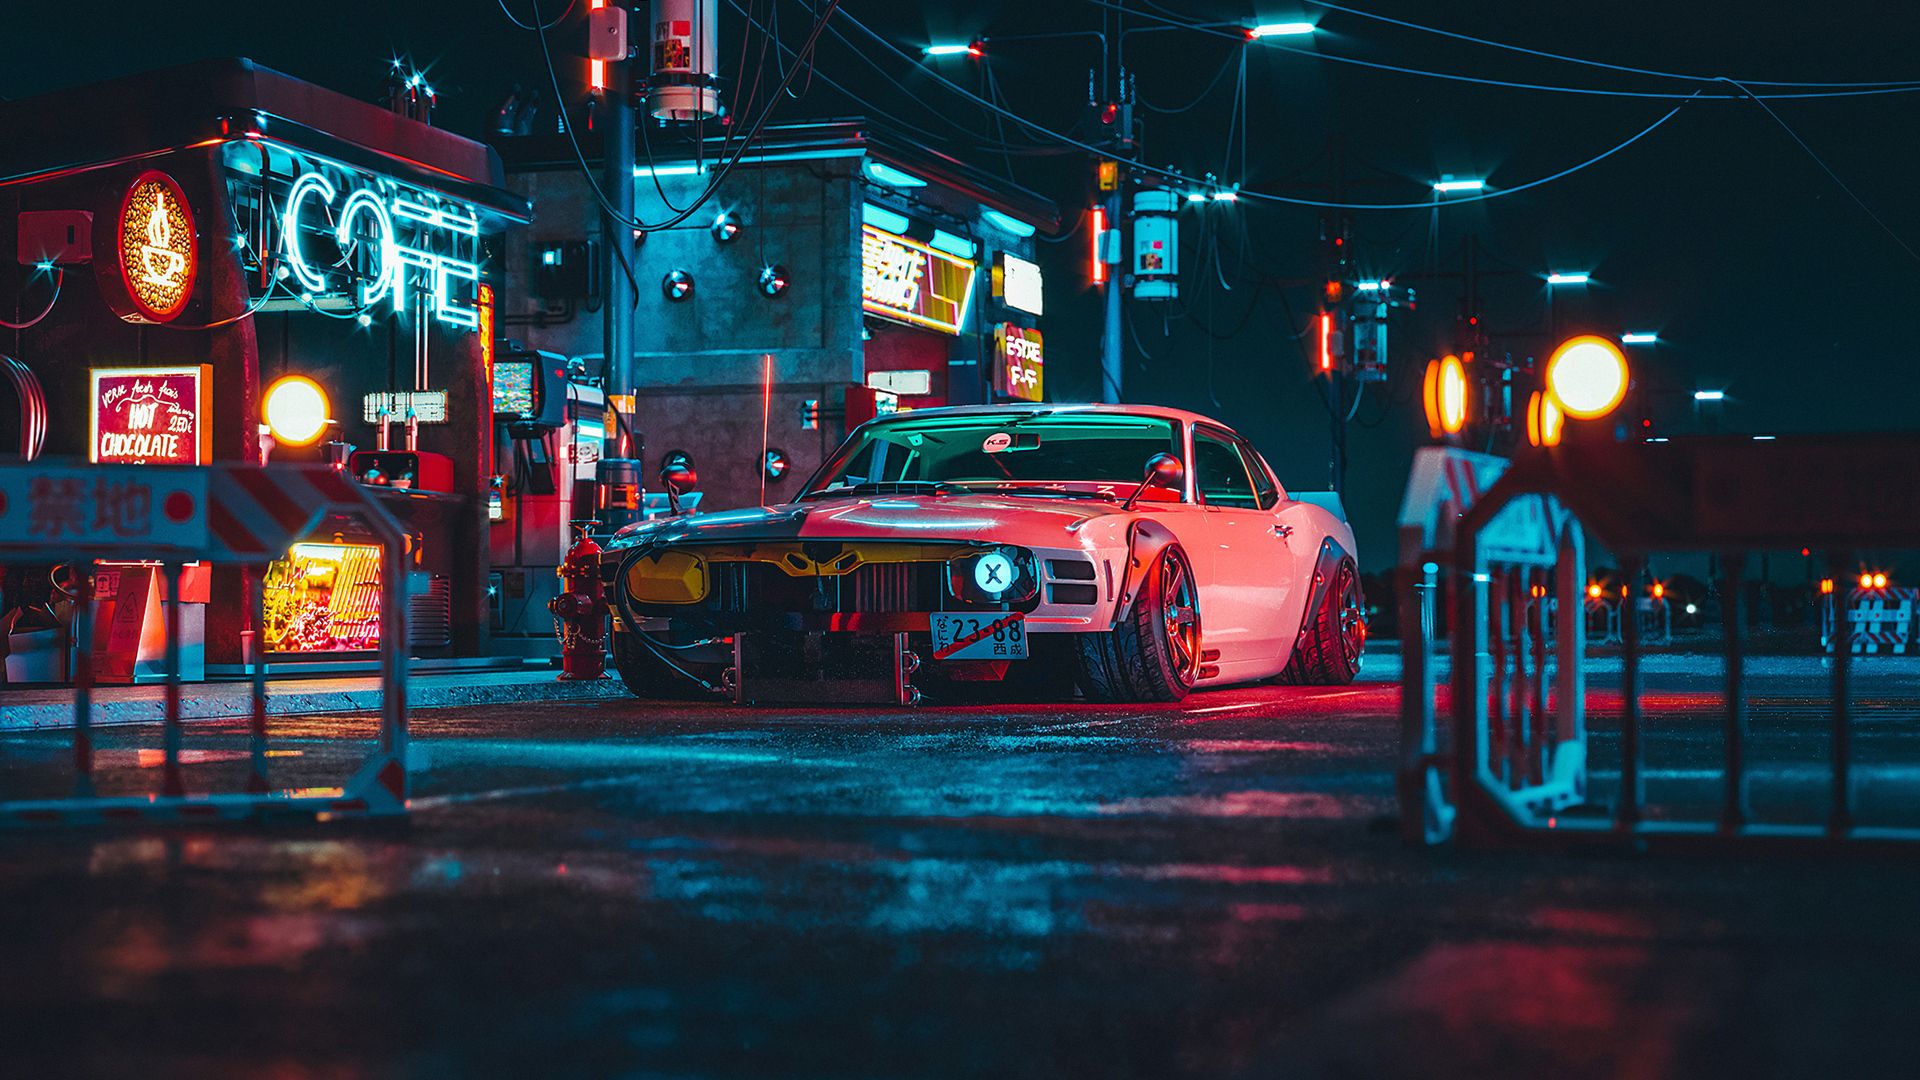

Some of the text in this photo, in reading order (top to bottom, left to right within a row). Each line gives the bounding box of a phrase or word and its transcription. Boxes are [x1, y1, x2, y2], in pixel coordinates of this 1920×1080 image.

[128, 402, 159, 429] HOT
[101, 432, 179, 457] CHOCOLATE
[952, 619, 1021, 642] 23-88
